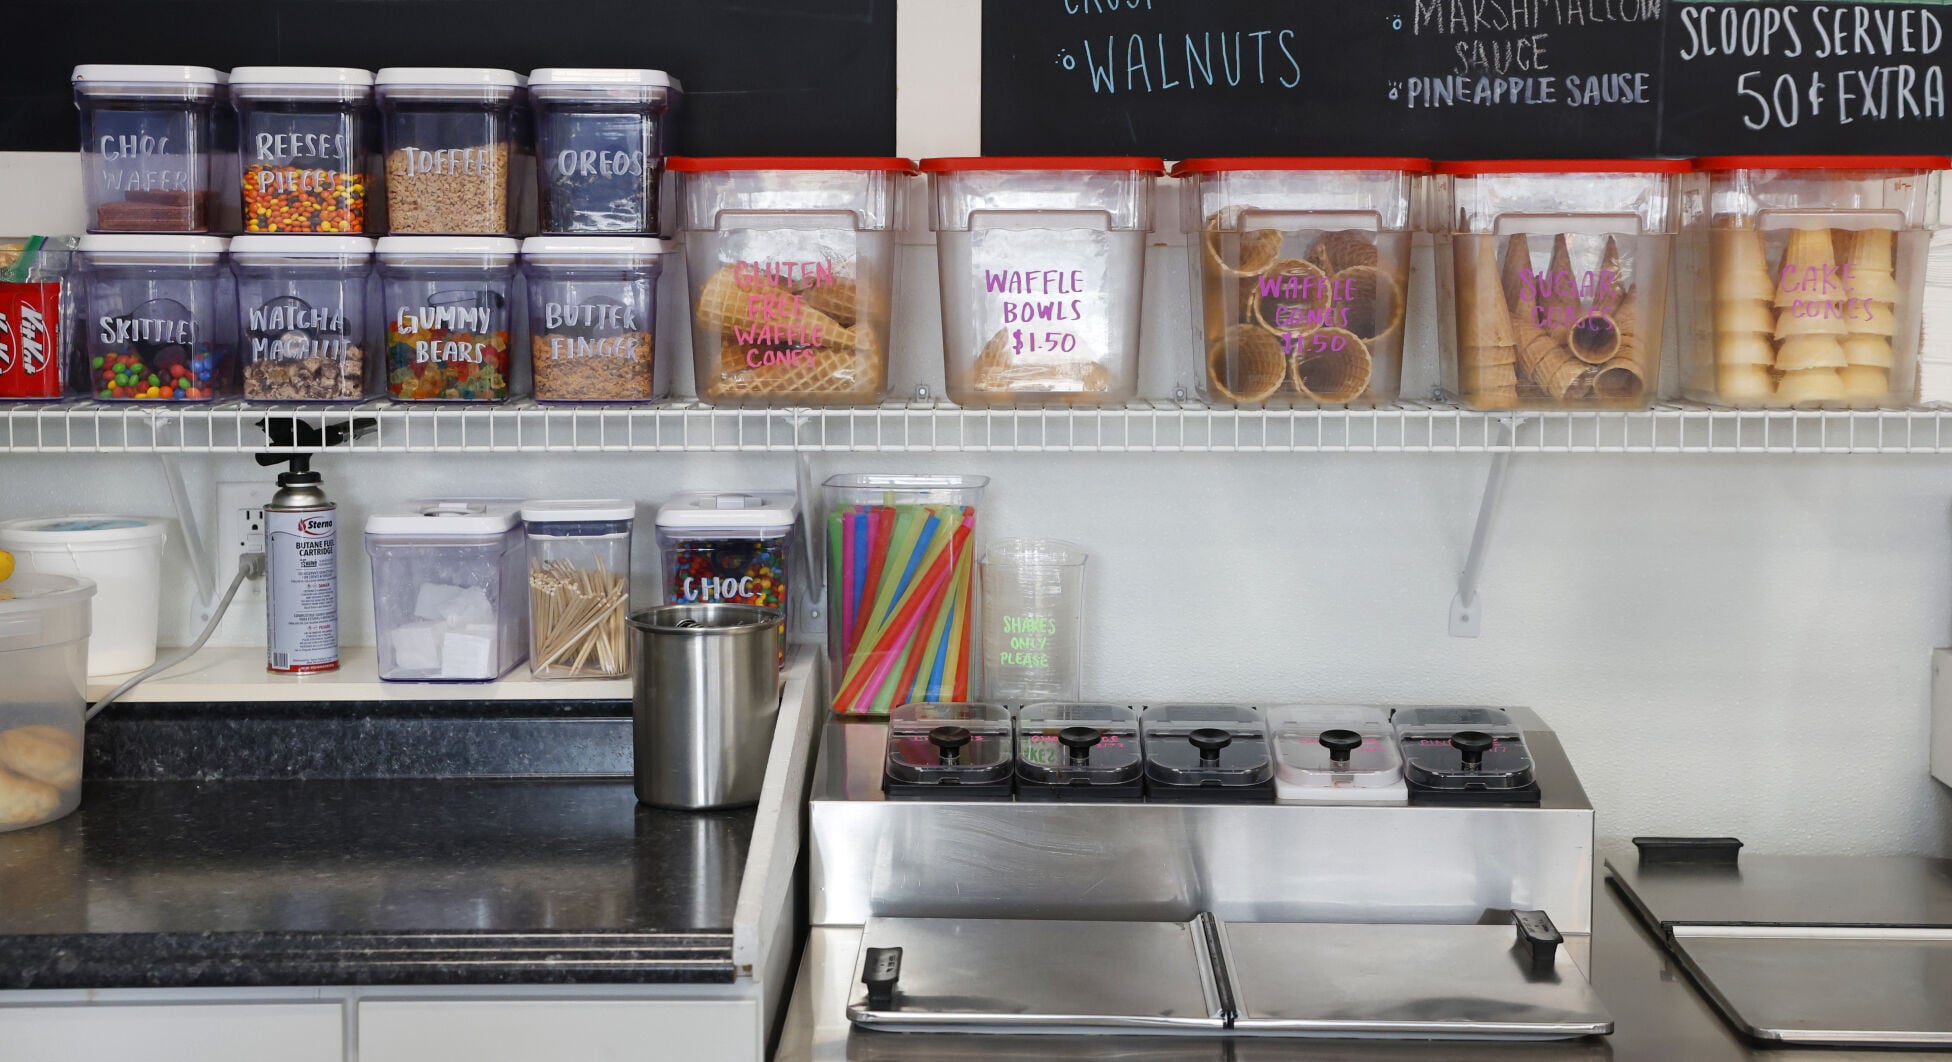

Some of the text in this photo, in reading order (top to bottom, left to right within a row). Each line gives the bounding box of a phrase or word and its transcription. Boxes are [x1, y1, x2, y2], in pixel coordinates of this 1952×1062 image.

[1680, 6, 1943, 60] SCOOPS SERVED
[1084, 30, 1301, 93] WALNUTS
[1454, 34, 1549, 75] SAUCE
[1407, 73, 1650, 108] PINEAPPLE SAUSE
[1837, 65, 1945, 124] EXTRA
[100, 134, 169, 161] CHOC
[256, 132, 344, 161] REESES
[557, 150, 644, 176] OREOS
[103, 169, 189, 193] WAFER
[258, 170, 336, 193] PIECES
[733, 259, 833, 289] GLUTEN
[985, 269, 1083, 294] WAFFLE
[1519, 268, 1617, 303] SUGAR
[1780, 263, 1857, 295] CAKE
[1258, 275, 1358, 301] WAFFLE
[249, 305, 343, 331] WATCHA
[545, 303, 638, 330] BUTTER
[748, 293, 804, 320] FREE
[1003, 299, 1082, 324] BOWLS
[1275, 304, 1350, 328] CONES
[1530, 304, 1615, 332] CONES
[1791, 297, 1874, 322] CONES
[99, 316, 198, 344] SKITTLES
[397, 306, 491, 334] GUMMY
[550, 336, 639, 361] FINGER
[734, 324, 824, 347] WAFFLE
[1012, 329, 1077, 355] $1.50
[1281, 331, 1348, 354] $1.50
[415, 340, 486, 364] BEARS
[746, 348, 816, 368] CONES
[307, 519, 334, 530] Sterno
[295, 541, 323, 550] BUTANE
[299, 547, 334, 557] CARTRIDGE
[1002, 615, 1056, 635] SHAKES
[1010, 636, 1047, 650] ONLY
[1000, 651, 1049, 668] PLEASE
